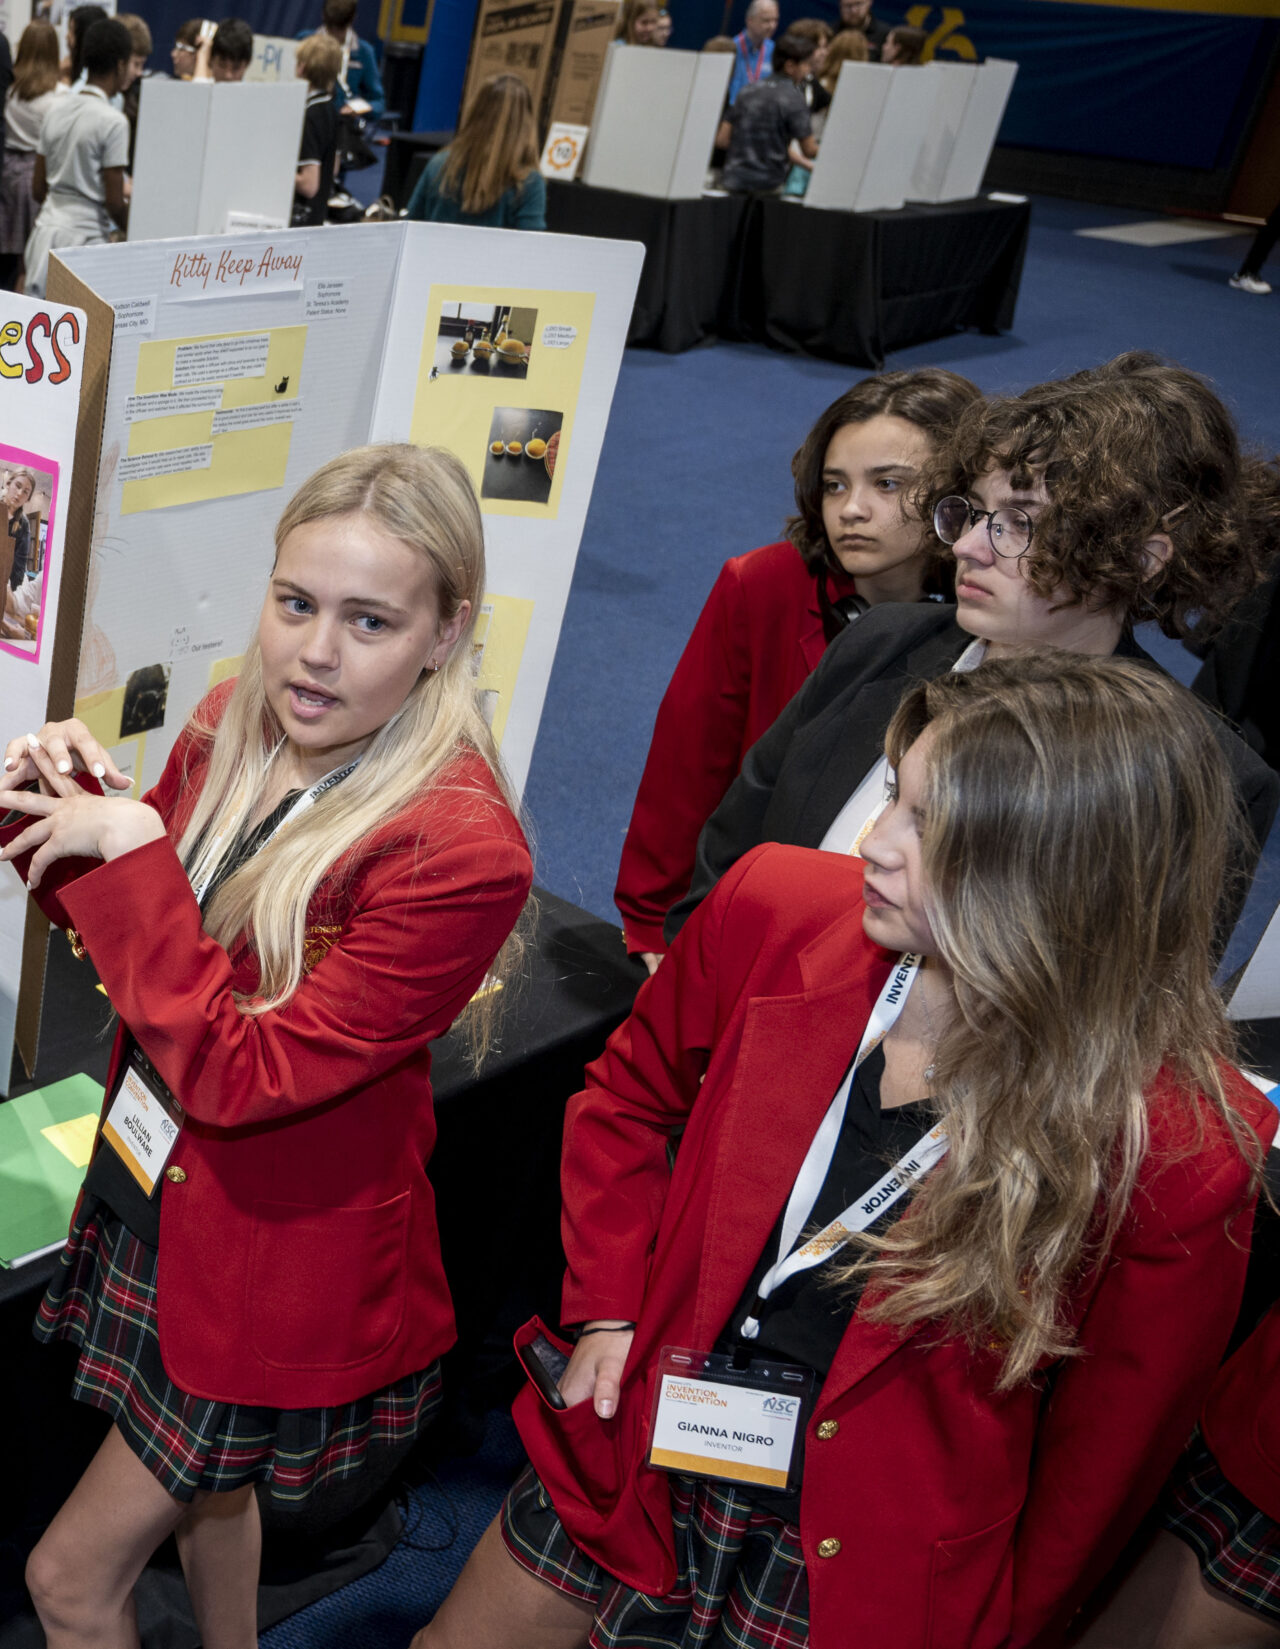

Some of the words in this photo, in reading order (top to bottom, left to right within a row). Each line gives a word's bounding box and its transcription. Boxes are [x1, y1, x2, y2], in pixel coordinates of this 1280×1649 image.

[170, 253, 212, 289] Kitty
[215, 250, 256, 286] Keep
[256, 246, 303, 281] Away
[124, 1116, 153, 1158] BOULWARE
[132, 1113, 152, 1143] LILLIAN
[861, 1159, 922, 1214] INVENTOR
[677, 1421, 728, 1439] GIANNA
[732, 1431, 775, 1447] NIGRO
[703, 1440, 744, 1453] INVENTOR
